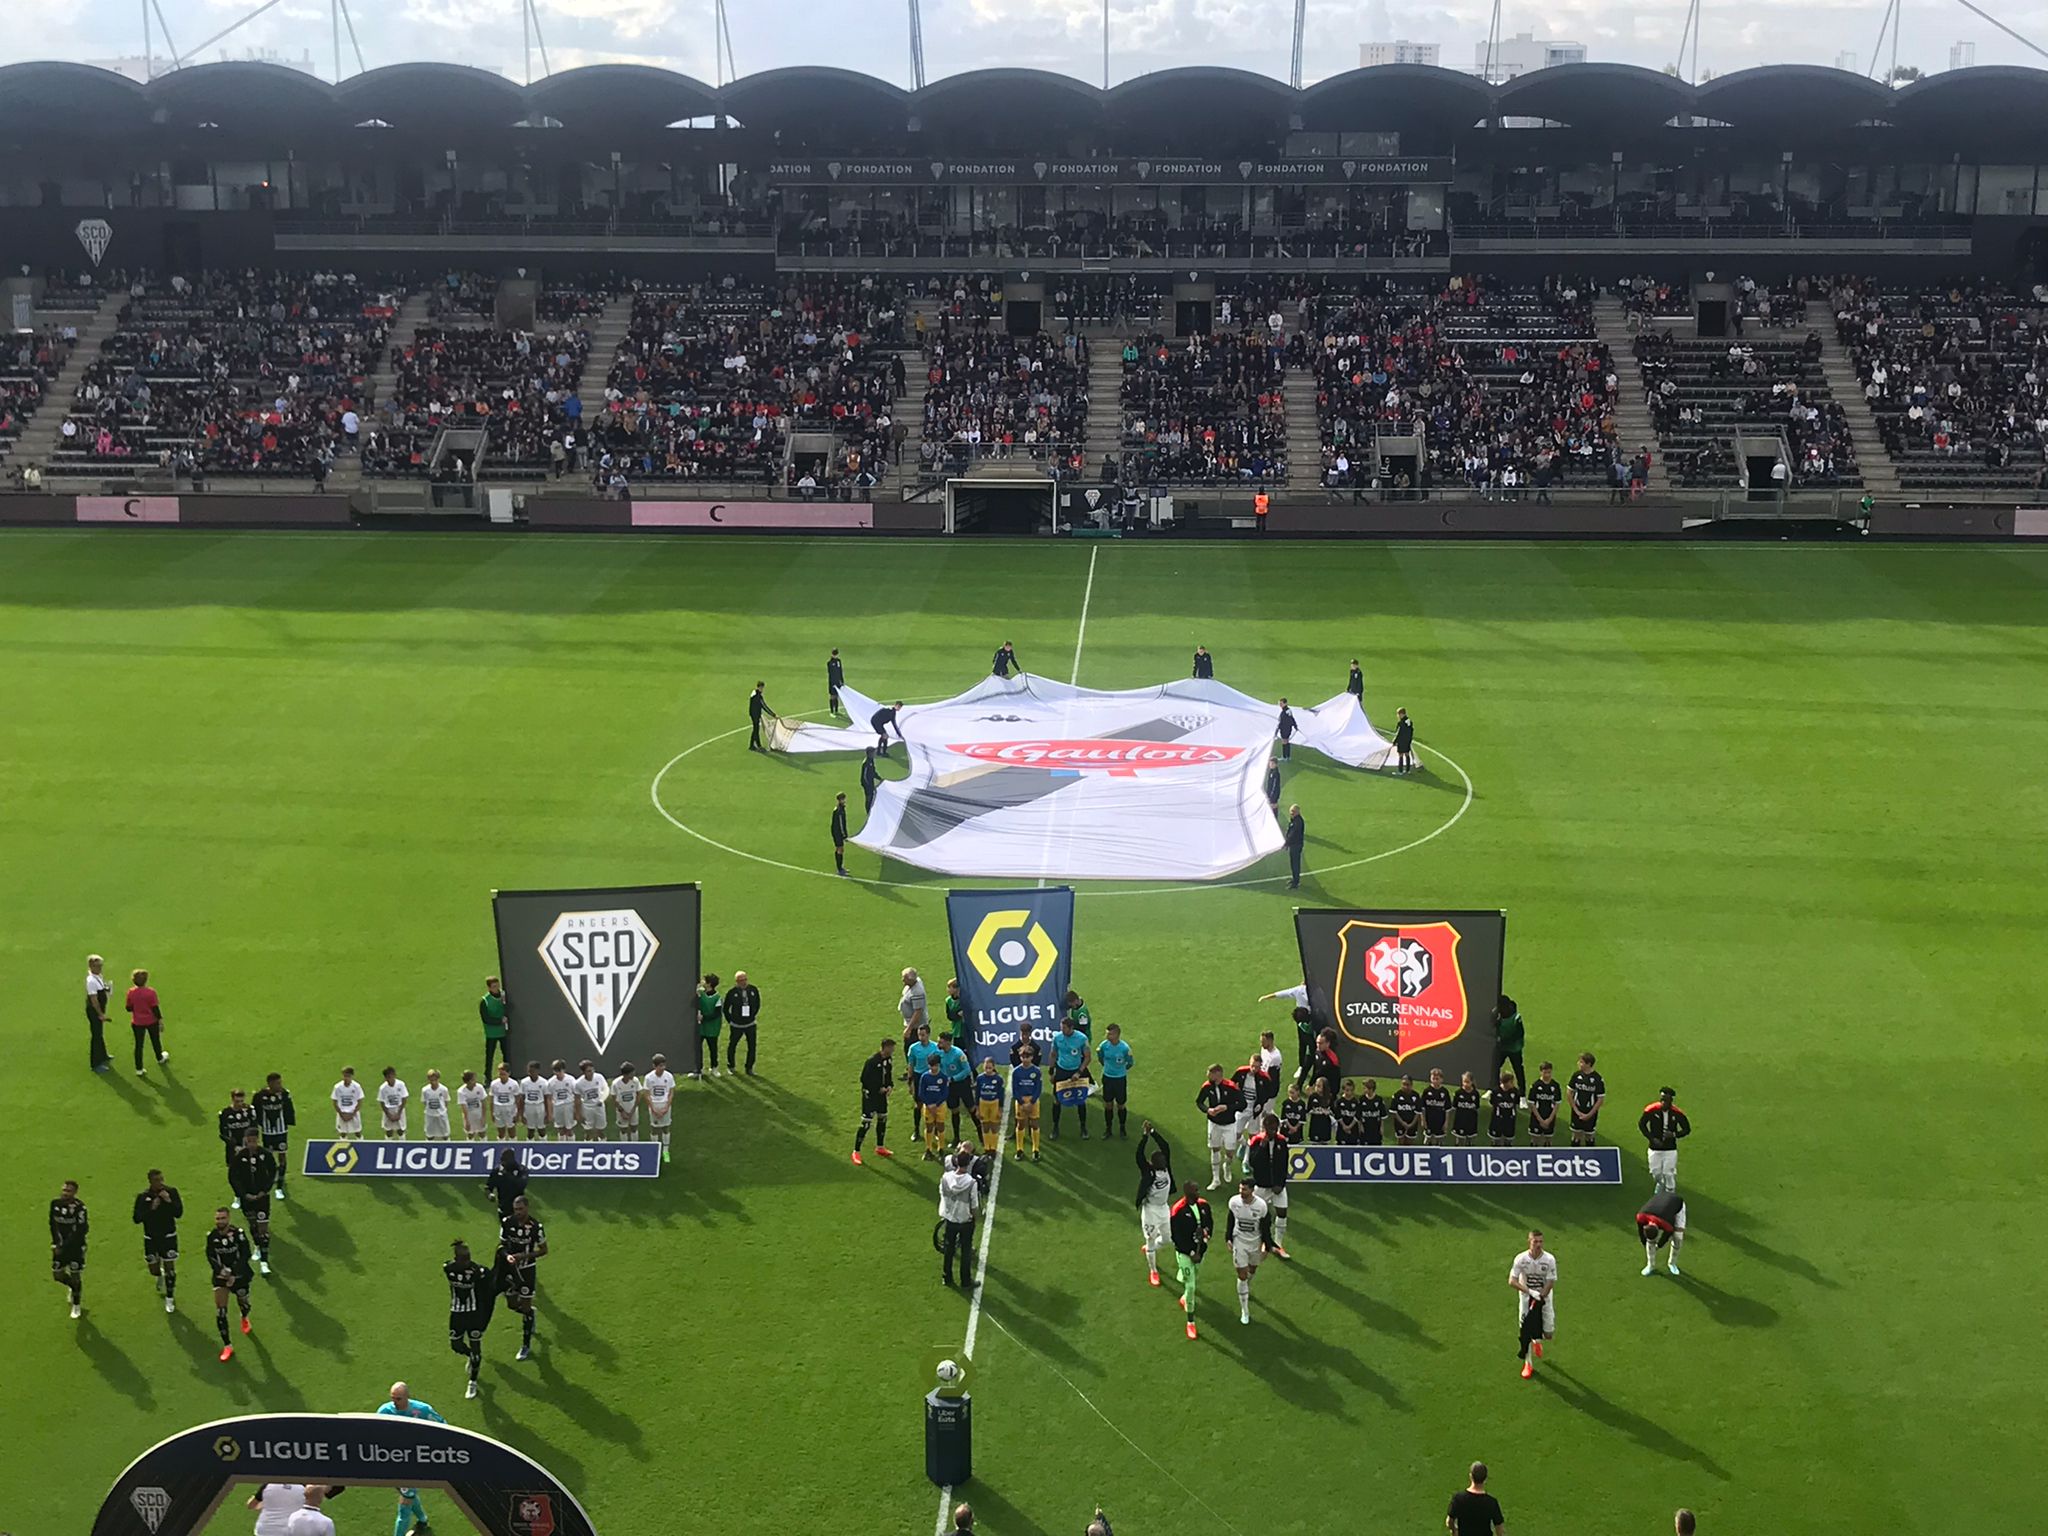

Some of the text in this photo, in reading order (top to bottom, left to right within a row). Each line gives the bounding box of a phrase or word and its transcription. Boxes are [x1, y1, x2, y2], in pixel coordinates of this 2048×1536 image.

[846, 164, 913, 174] FONDATION
[949, 164, 1015, 174] FONDATION
[1052, 164, 1119, 174] FONDATION
[1155, 164, 1222, 174] FONDATION
[1257, 164, 1325, 173] FONDATION
[1361, 162, 1429, 173] FONDATION
[82, 226, 106, 239] SCO
[997, 742, 1227, 763] Gaulois
[567, 916, 629, 929] ANGERS
[563, 929, 635, 970] SCO
[978, 1003, 1055, 1025] LIGUE 1
[1346, 1001, 1453, 1020] STADE RENNAIS
[1361, 1016, 1438, 1028] FOOTBALL CLUB
[974, 1030, 1017, 1046] Uber
[376, 1147, 473, 1170] LIGUE
[482, 1147, 495, 1170] 1
[576, 1148, 640, 1171] Eats
[1333, 1152, 1601, 1177] LIGUE 1 Uber Eats
[249, 1440, 470, 1464] LIGUE 1 Uber Eats
[137, 1493, 163, 1507] SCO
